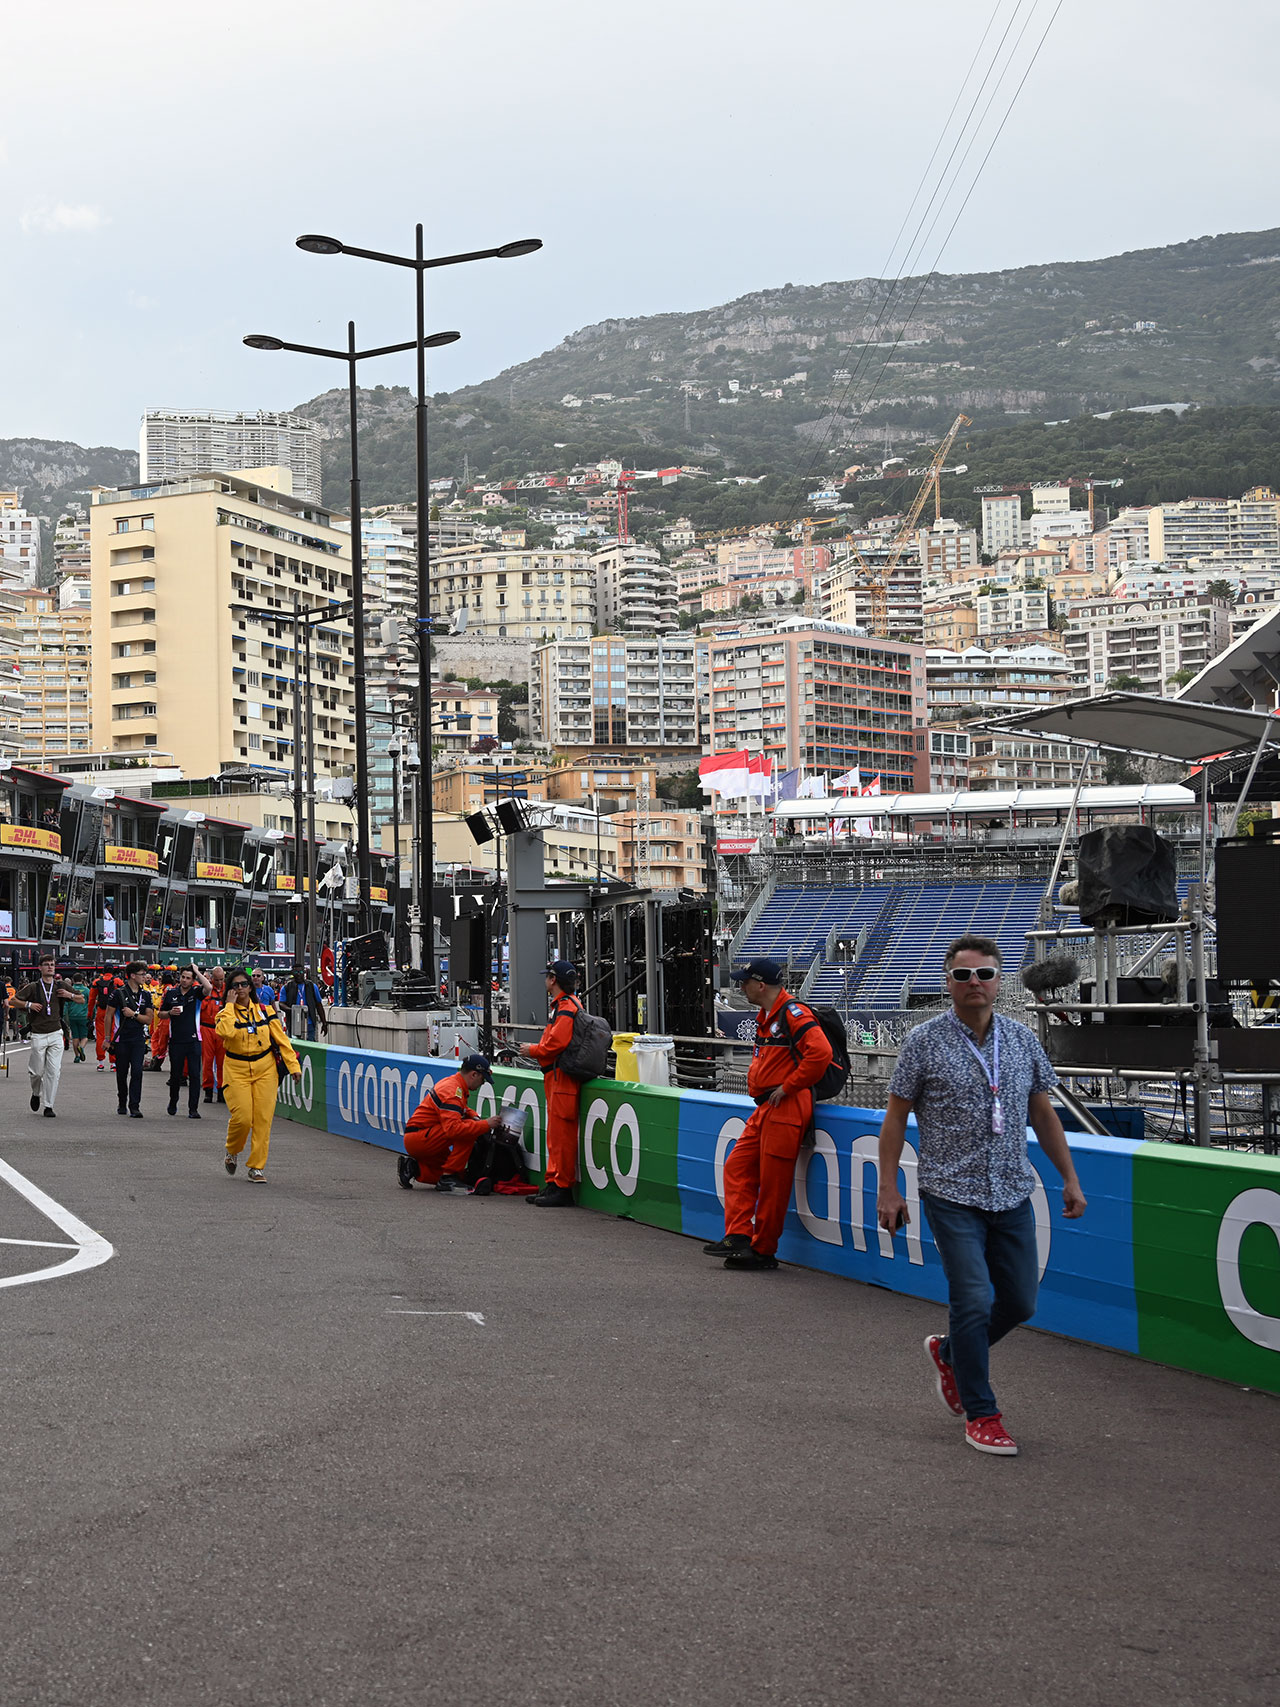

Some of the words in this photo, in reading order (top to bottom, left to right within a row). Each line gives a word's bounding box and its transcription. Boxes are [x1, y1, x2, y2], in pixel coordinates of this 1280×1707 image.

[14, 828, 38, 844] DHL
[117, 849, 138, 863] DHL
[207, 865, 225, 877] DHL
